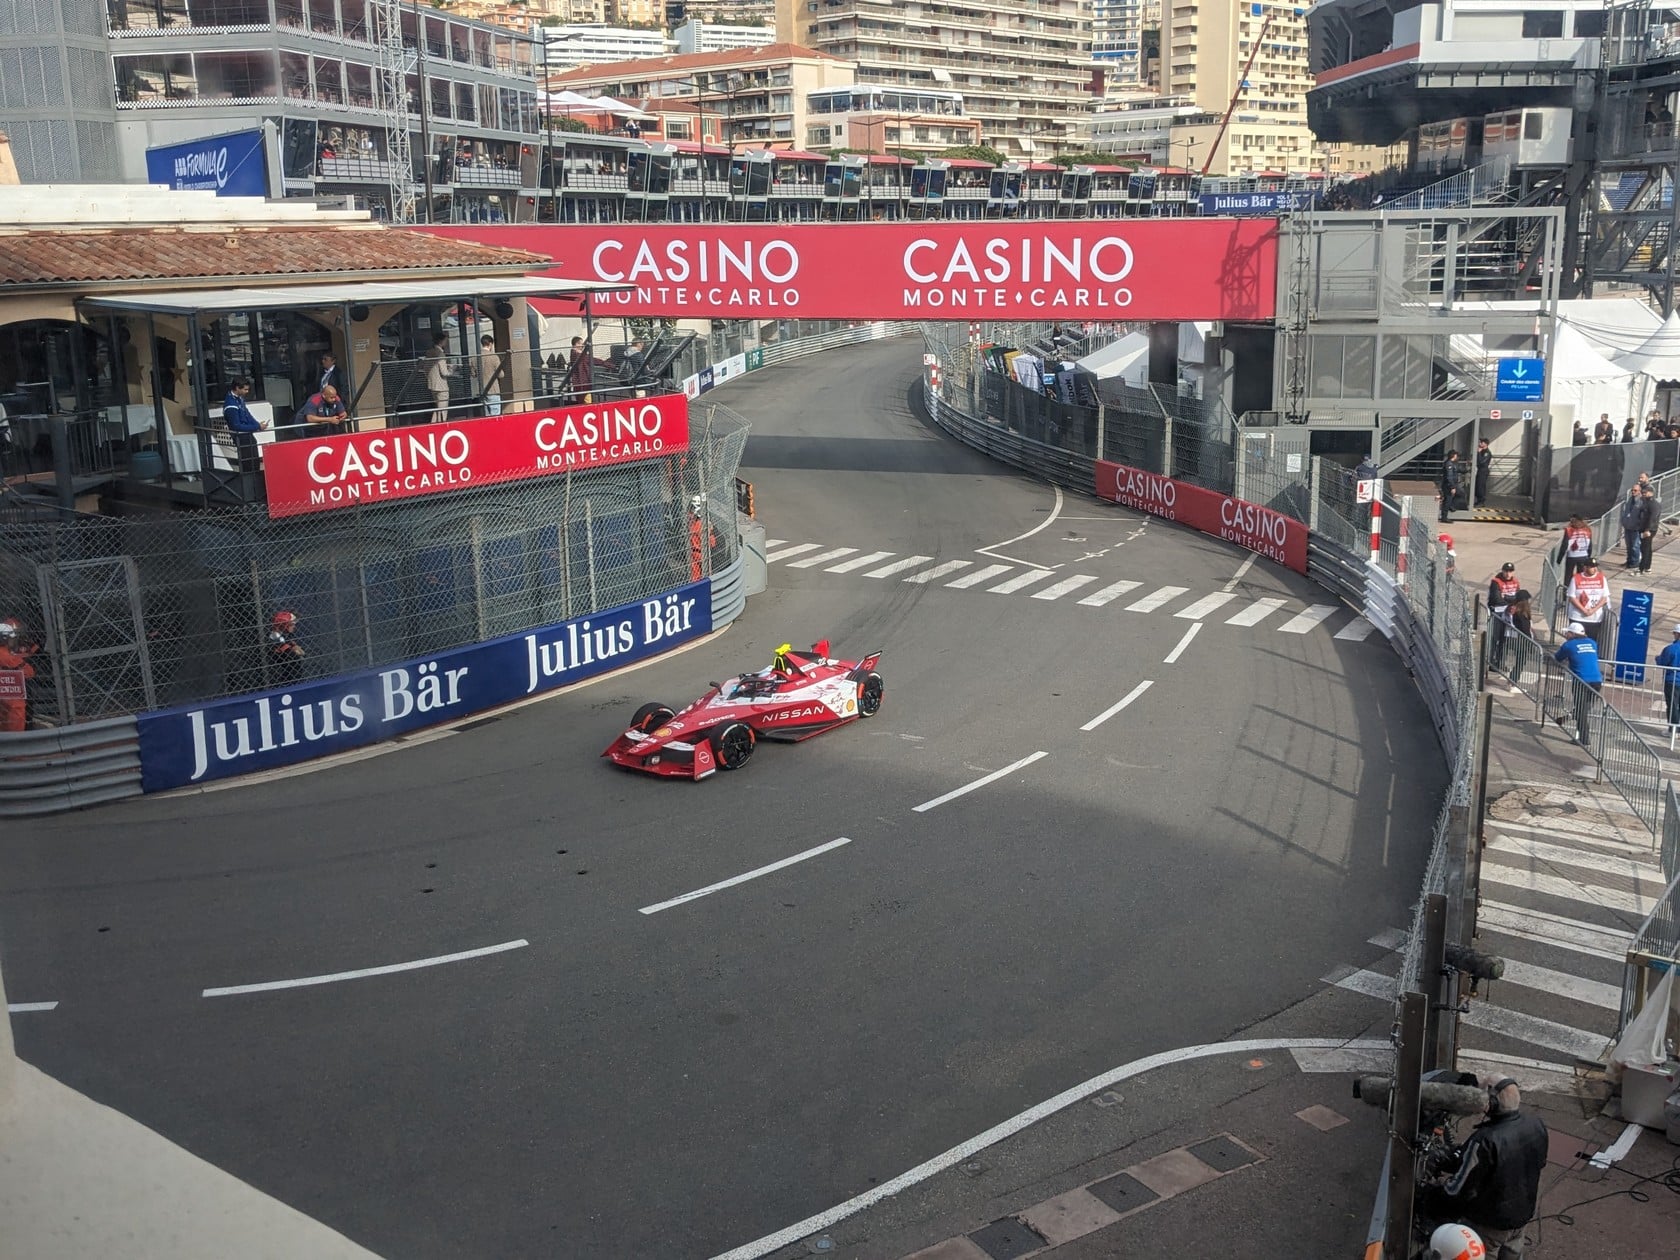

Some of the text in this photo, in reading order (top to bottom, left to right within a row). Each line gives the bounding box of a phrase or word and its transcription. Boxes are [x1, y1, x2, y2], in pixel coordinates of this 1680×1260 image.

[1214, 196, 1248, 210] Julius
[1251, 195, 1274, 208] Bär
[592, 236, 1134, 283] CASINO CASINO
[594, 287, 800, 306] MONTE CARLO
[903, 288, 1133, 306] MONTE CARLO
[307, 404, 662, 483] CASINO CASINO
[536, 438, 663, 469] MONTE CARLO
[310, 467, 472, 505] MONTE CARLO
[1115, 492, 1175, 521] MONTE CARLO
[1116, 468, 1287, 546] CASINO CASINO
[1220, 526, 1285, 562] MONTE CARLO
[525, 594, 696, 694] Julius Bär
[187, 661, 469, 780] Julius Bär
[762, 705, 825, 722] NISSAN
